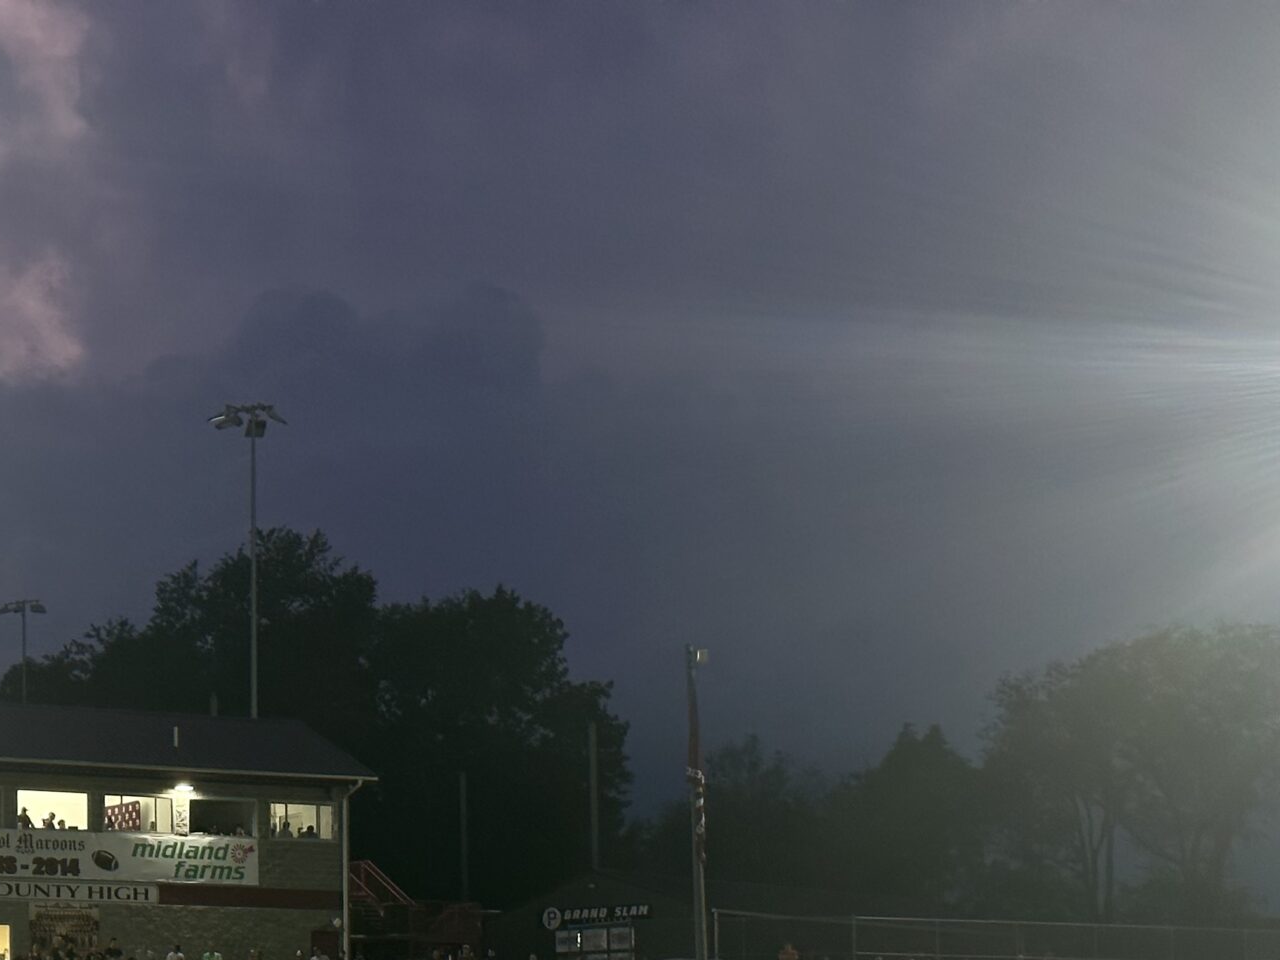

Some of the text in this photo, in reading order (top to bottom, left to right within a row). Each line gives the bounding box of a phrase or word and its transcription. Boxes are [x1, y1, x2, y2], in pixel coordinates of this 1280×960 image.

[16, 833, 86, 853] Maroons
[132, 841, 229, 861] midland
[174, 861, 245, 881] farms
[88, 883, 150, 901] HIGH
[564, 905, 649, 920] GRAND SLAM
